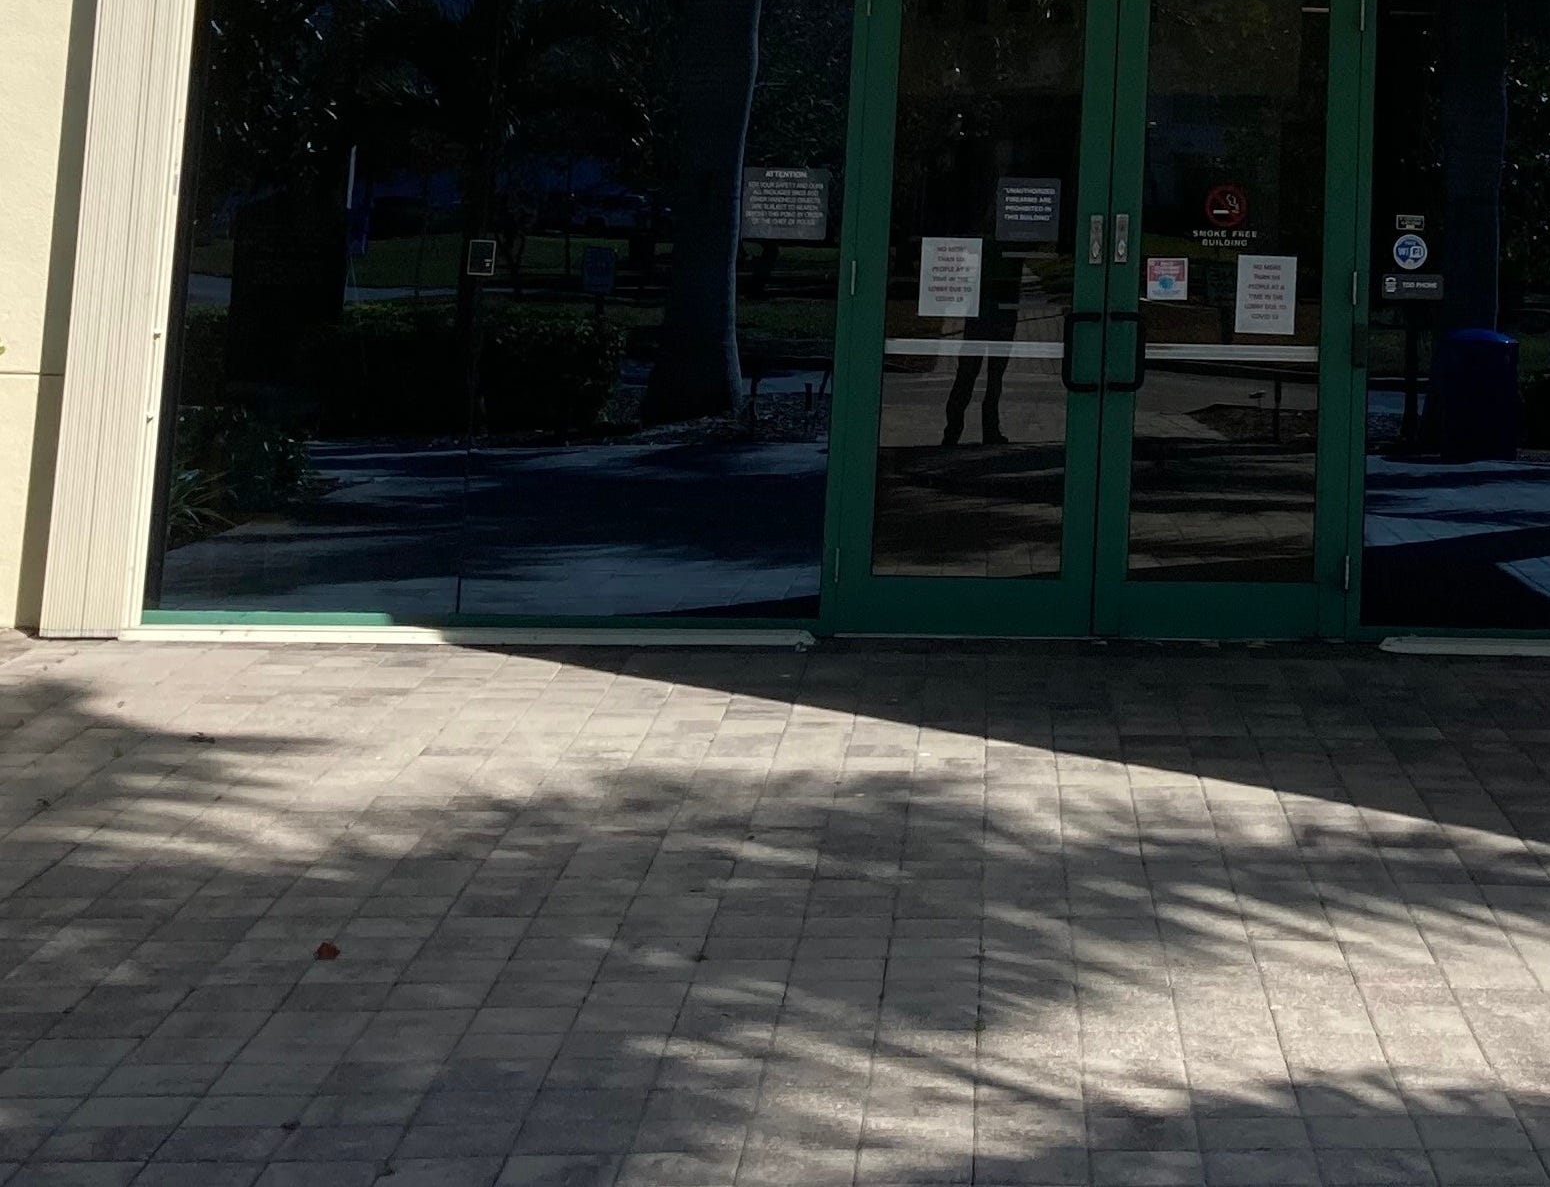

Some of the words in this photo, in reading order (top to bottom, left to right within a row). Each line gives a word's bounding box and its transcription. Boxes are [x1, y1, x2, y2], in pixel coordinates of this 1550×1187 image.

[1193, 230, 1227, 238] SMOKE
[1232, 230, 1257, 238] FREE
[1202, 238, 1248, 247] BUILDING
